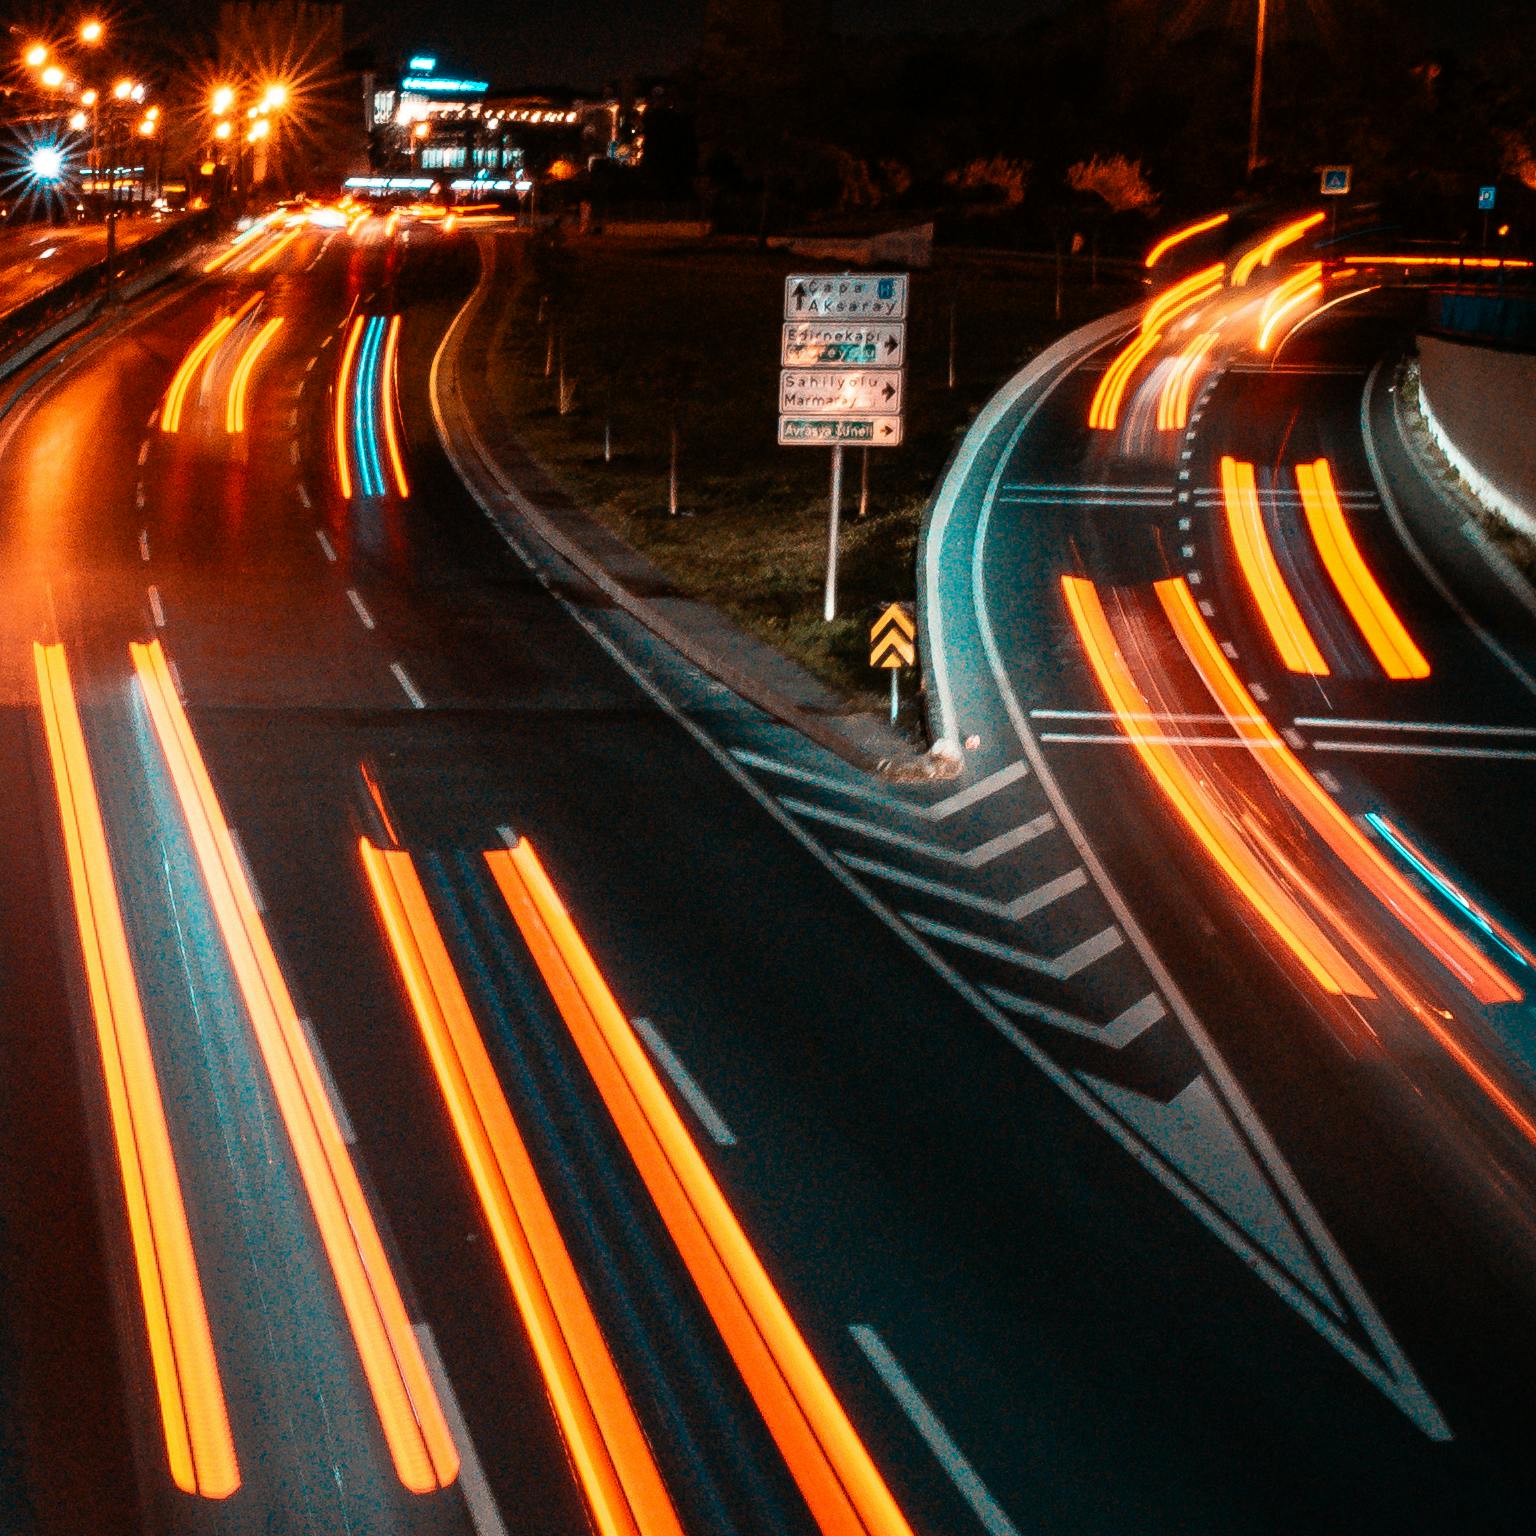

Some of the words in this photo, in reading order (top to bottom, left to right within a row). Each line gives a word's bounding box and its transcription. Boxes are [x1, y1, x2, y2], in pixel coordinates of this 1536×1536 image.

[808, 299, 898, 315] Aksaray
[785, 375, 878, 390] Sahilyolu
[784, 394, 857, 409] Marmaray
